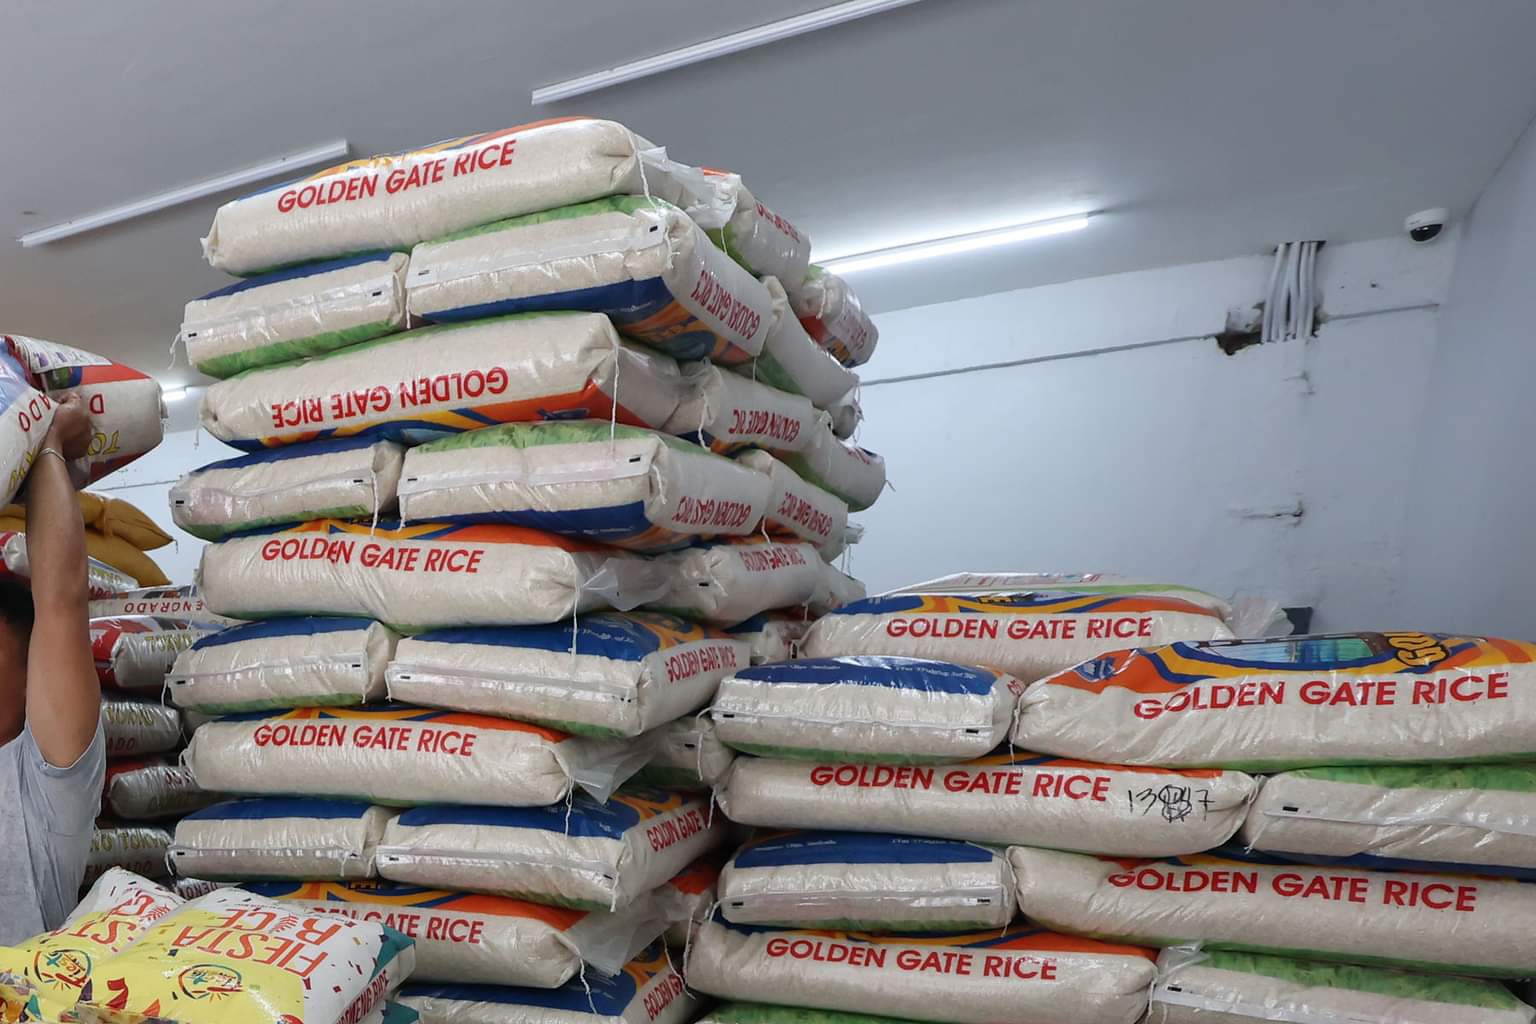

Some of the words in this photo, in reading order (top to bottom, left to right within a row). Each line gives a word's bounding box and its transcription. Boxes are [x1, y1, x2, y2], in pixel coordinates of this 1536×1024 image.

[277, 174, 378, 214] GOLDEN
[384, 158, 446, 195] GATE
[452, 139, 517, 179] RICE
[331, 385, 393, 420] GATE
[399, 366, 509, 406] GOLDEN
[271, 398, 324, 429] RICE
[261, 537, 355, 564] GOLDEN
[359, 542, 418, 573] GATE
[423, 547, 485, 574] RICE
[123, 599, 205, 614] ENORADO
[886, 616, 1001, 641] GOLDEN
[1006, 617, 1081, 641] GATE
[1086, 616, 1153, 641] RICE
[1133, 680, 1284, 720] GOLDEN
[1297, 680, 1397, 707] GATE
[1411, 670, 1511, 706] RICE
[253, 723, 347, 749] GOLDEN
[352, 724, 413, 753] GATE
[417, 727, 478, 758] RICE
[809, 764, 933, 793] GOLDEN
[941, 768, 1023, 799] GATE
[1032, 772, 1111, 803] RICE
[1108, 863, 1258, 896] GOLDEN
[1271, 872, 1368, 906] GATE
[1382, 876, 1478, 912] RICE
[426, 915, 485, 945] RICE
[172, 926, 330, 978] FIESTA
[766, 937, 886, 969] GOLDEN
[896, 949, 973, 976] GATE
[981, 953, 1058, 981] RICE
